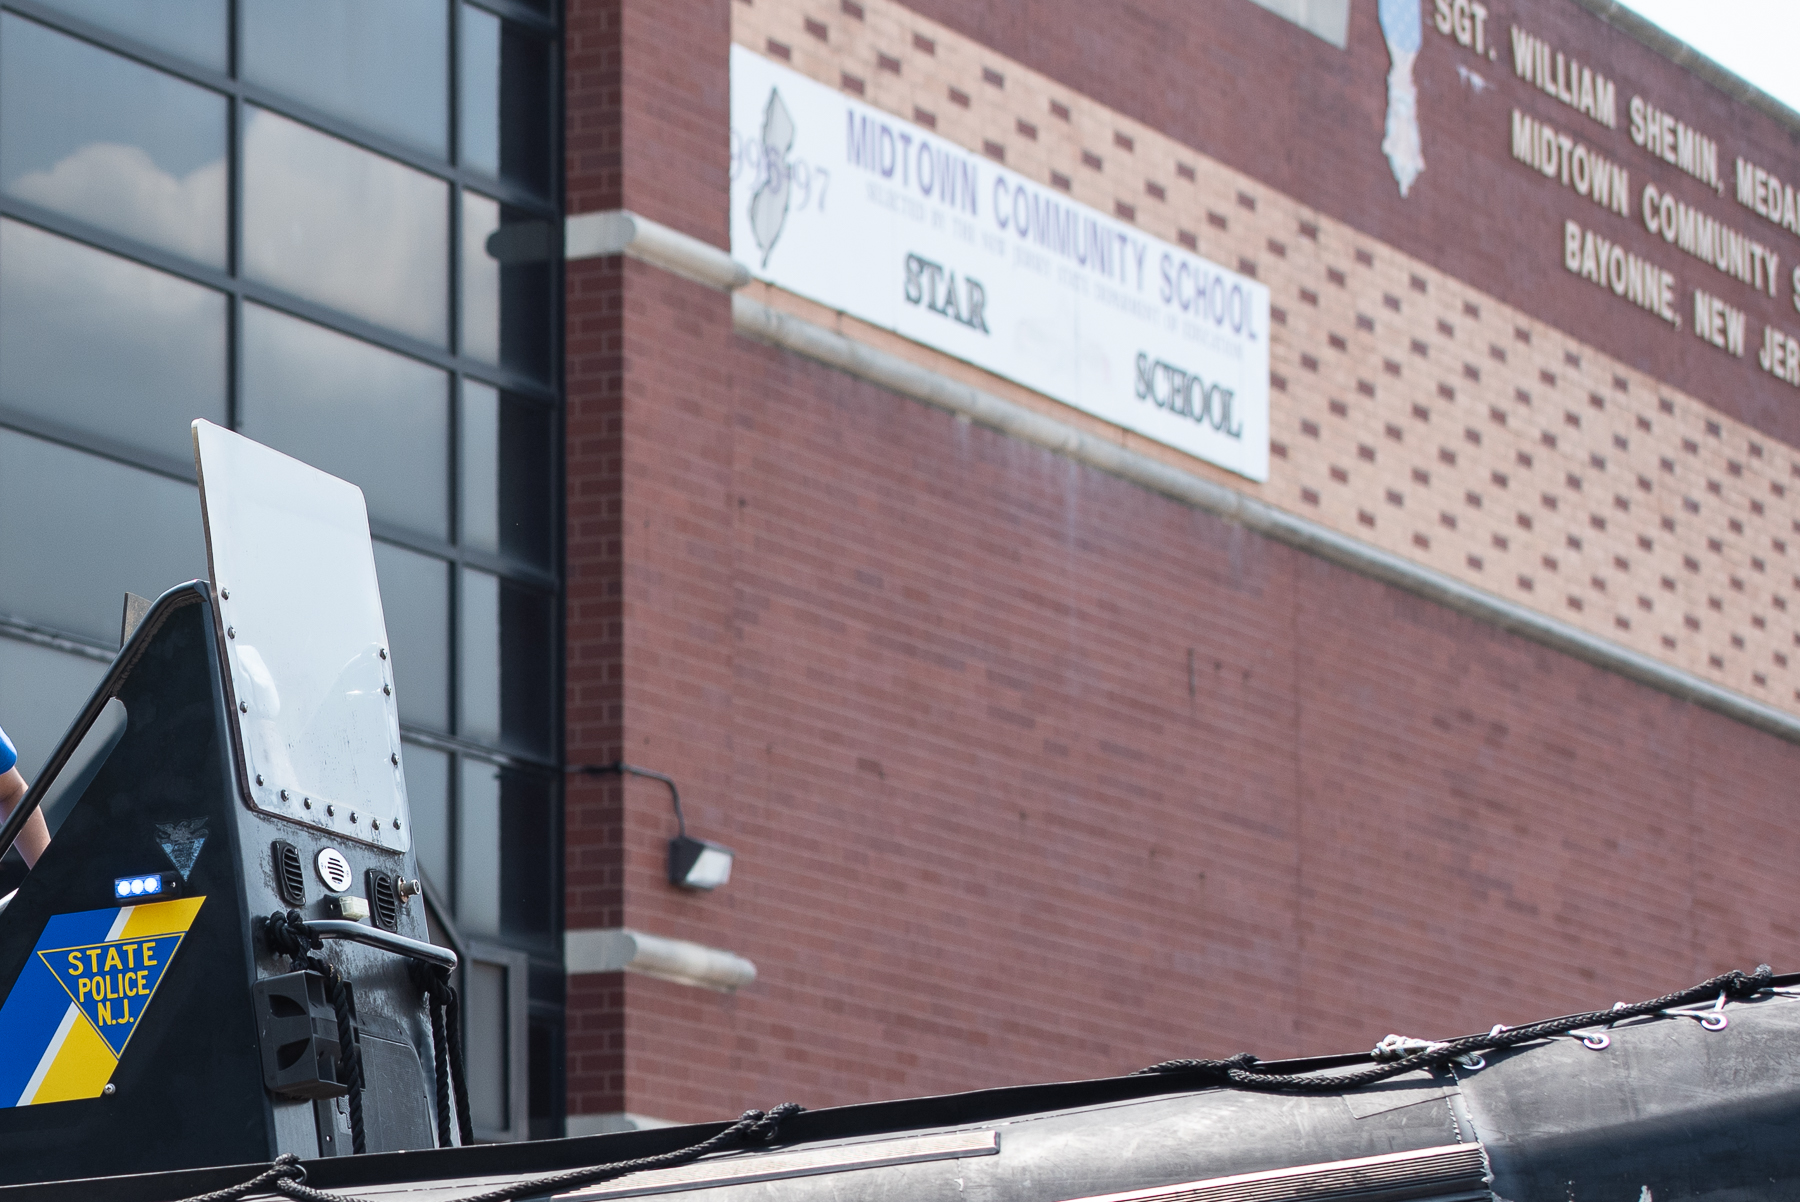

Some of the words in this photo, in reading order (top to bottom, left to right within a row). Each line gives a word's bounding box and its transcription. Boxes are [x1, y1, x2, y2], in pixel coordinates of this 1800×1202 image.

[1434, 0, 1497, 61] SGT.
[1511, 24, 1616, 129] WILLIAM
[1630, 94, 1724, 196] SHEMIN,
[846, 109, 977, 216] MIDTOWN
[992, 175, 1147, 291] COMMUNITY
[1159, 252, 1258, 341] SCHOOL
[1512, 108, 1630, 218] MIDTOWN
[1642, 182, 1779, 297] COMMUNITY
[904, 252, 991, 336] STAR
[1565, 219, 1681, 330] BAYONNE,
[1694, 288, 1745, 358] NEW
[1134, 351, 1242, 440] SCHOOL
[67, 941, 158, 976] STATE
[78, 970, 150, 1002] POLICE
[97, 998, 134, 1026] N.J.
